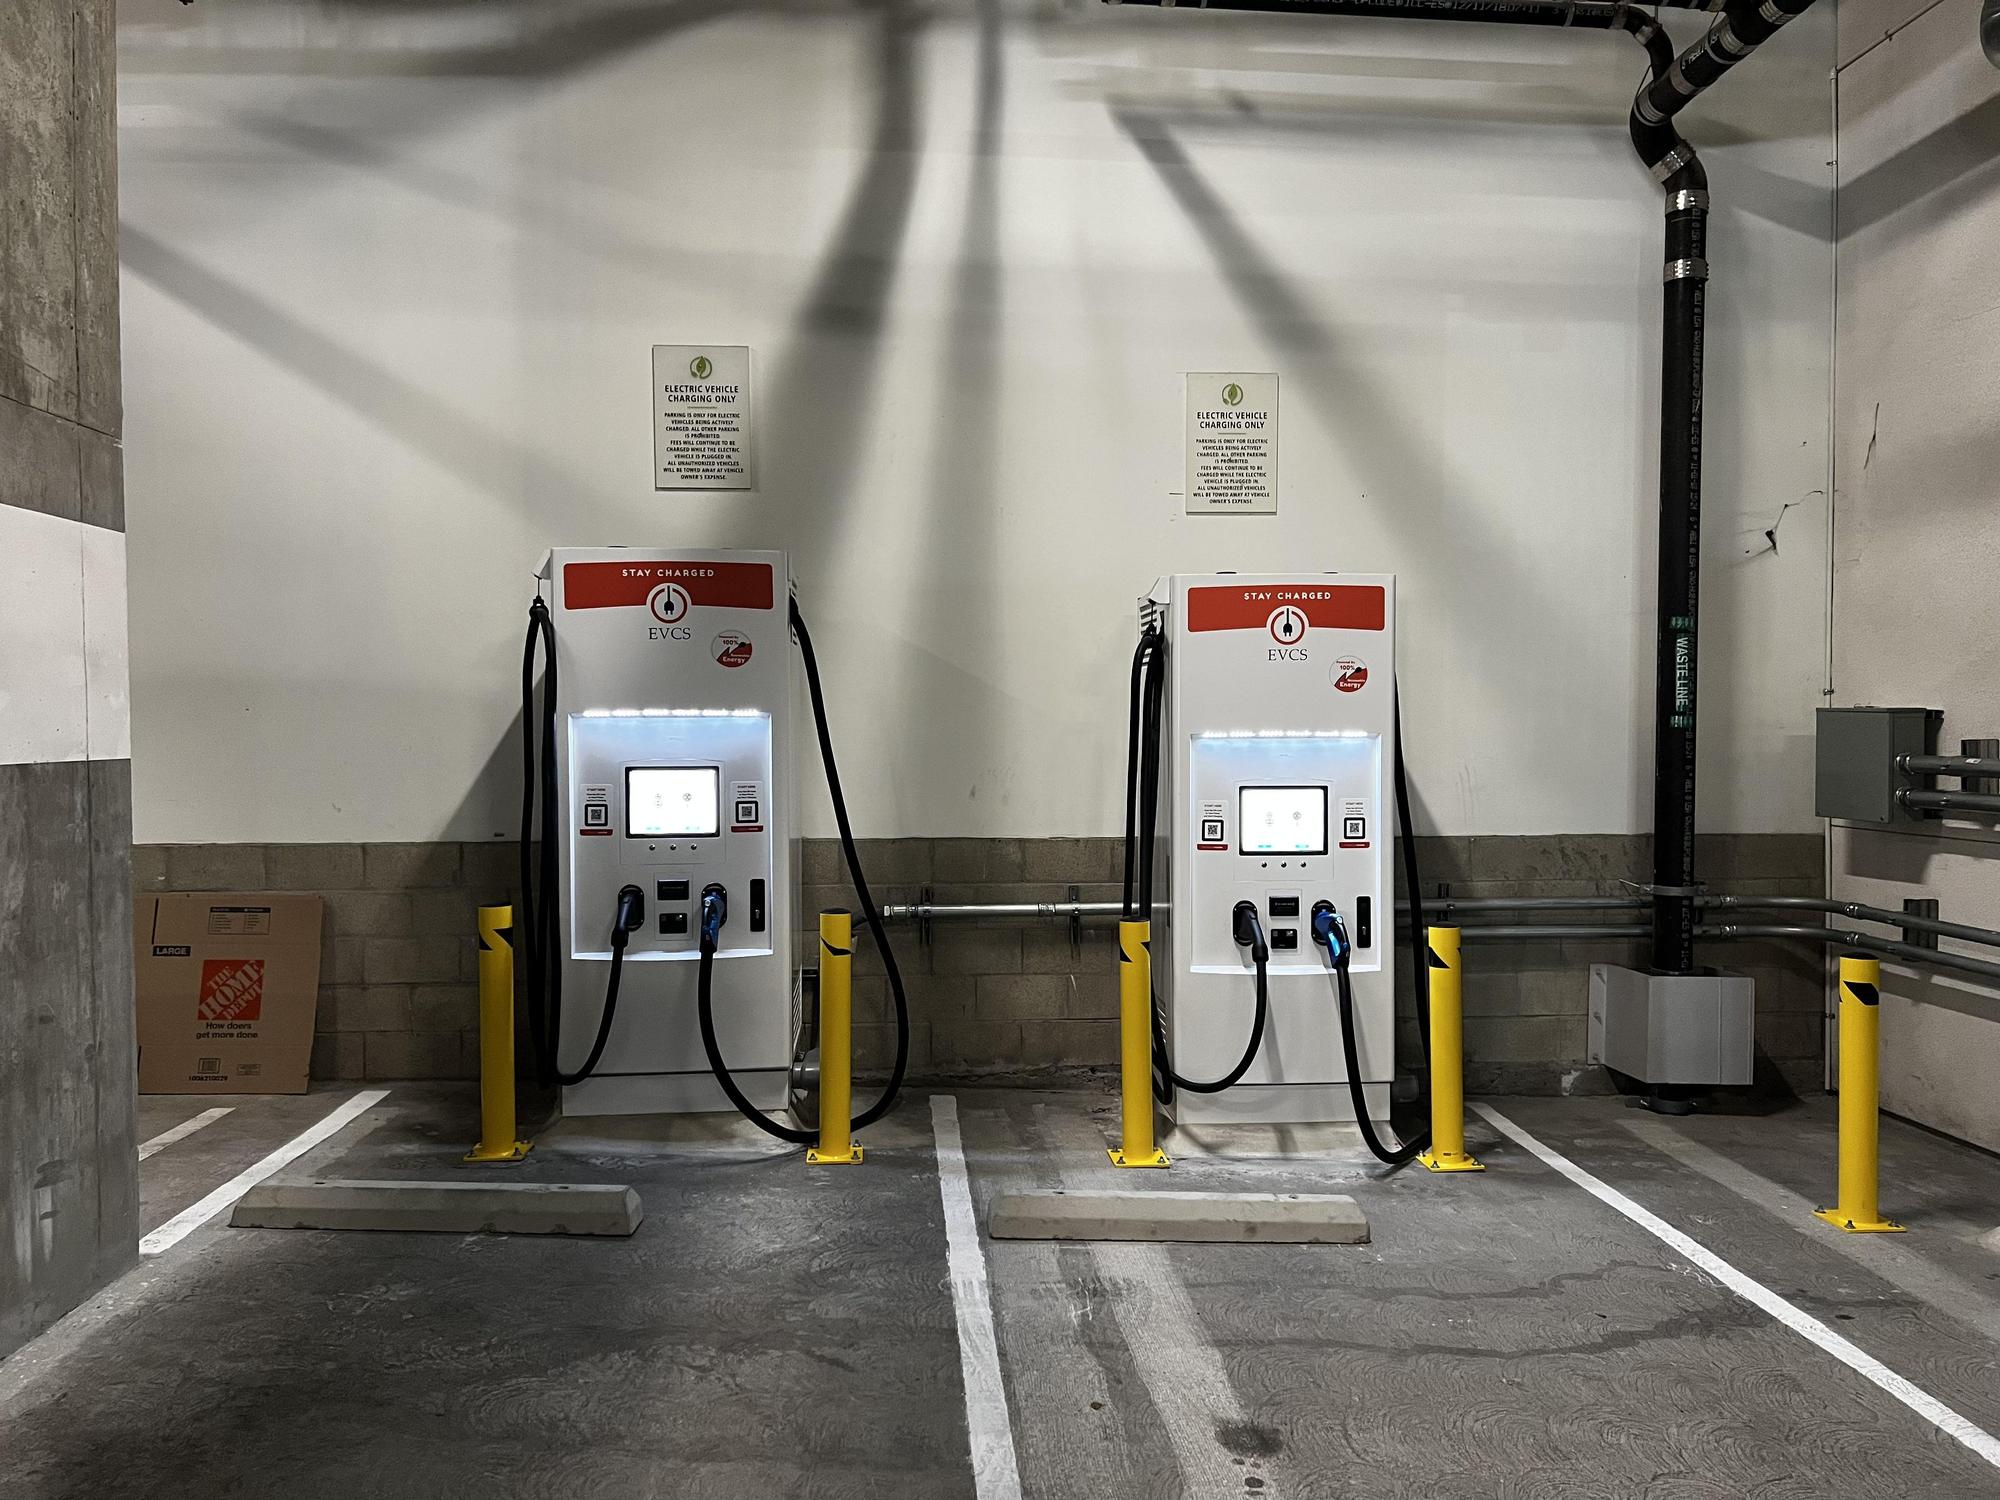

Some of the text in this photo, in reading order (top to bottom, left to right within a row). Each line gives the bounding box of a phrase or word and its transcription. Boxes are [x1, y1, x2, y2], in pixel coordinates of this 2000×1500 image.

[664, 384, 739, 393] ELECTRIC VEHICLE
[668, 394, 736, 403] CHARGING ONLY
[622, 569, 715, 577] STAY CHARGED
[1243, 592, 1272, 600] STAY
[648, 627, 691, 640] EVCS
[1268, 649, 1308, 661] EVCS
[1676, 638, 1688, 706] WASTE LINE
[156, 947, 187, 955] LARGE
[207, 966, 234, 990] THE
[198, 960, 264, 1020] HOME
[222, 981, 263, 1019] DEPOT
[227, 1022, 252, 1030] doers
[196, 1031, 210, 1039] get
